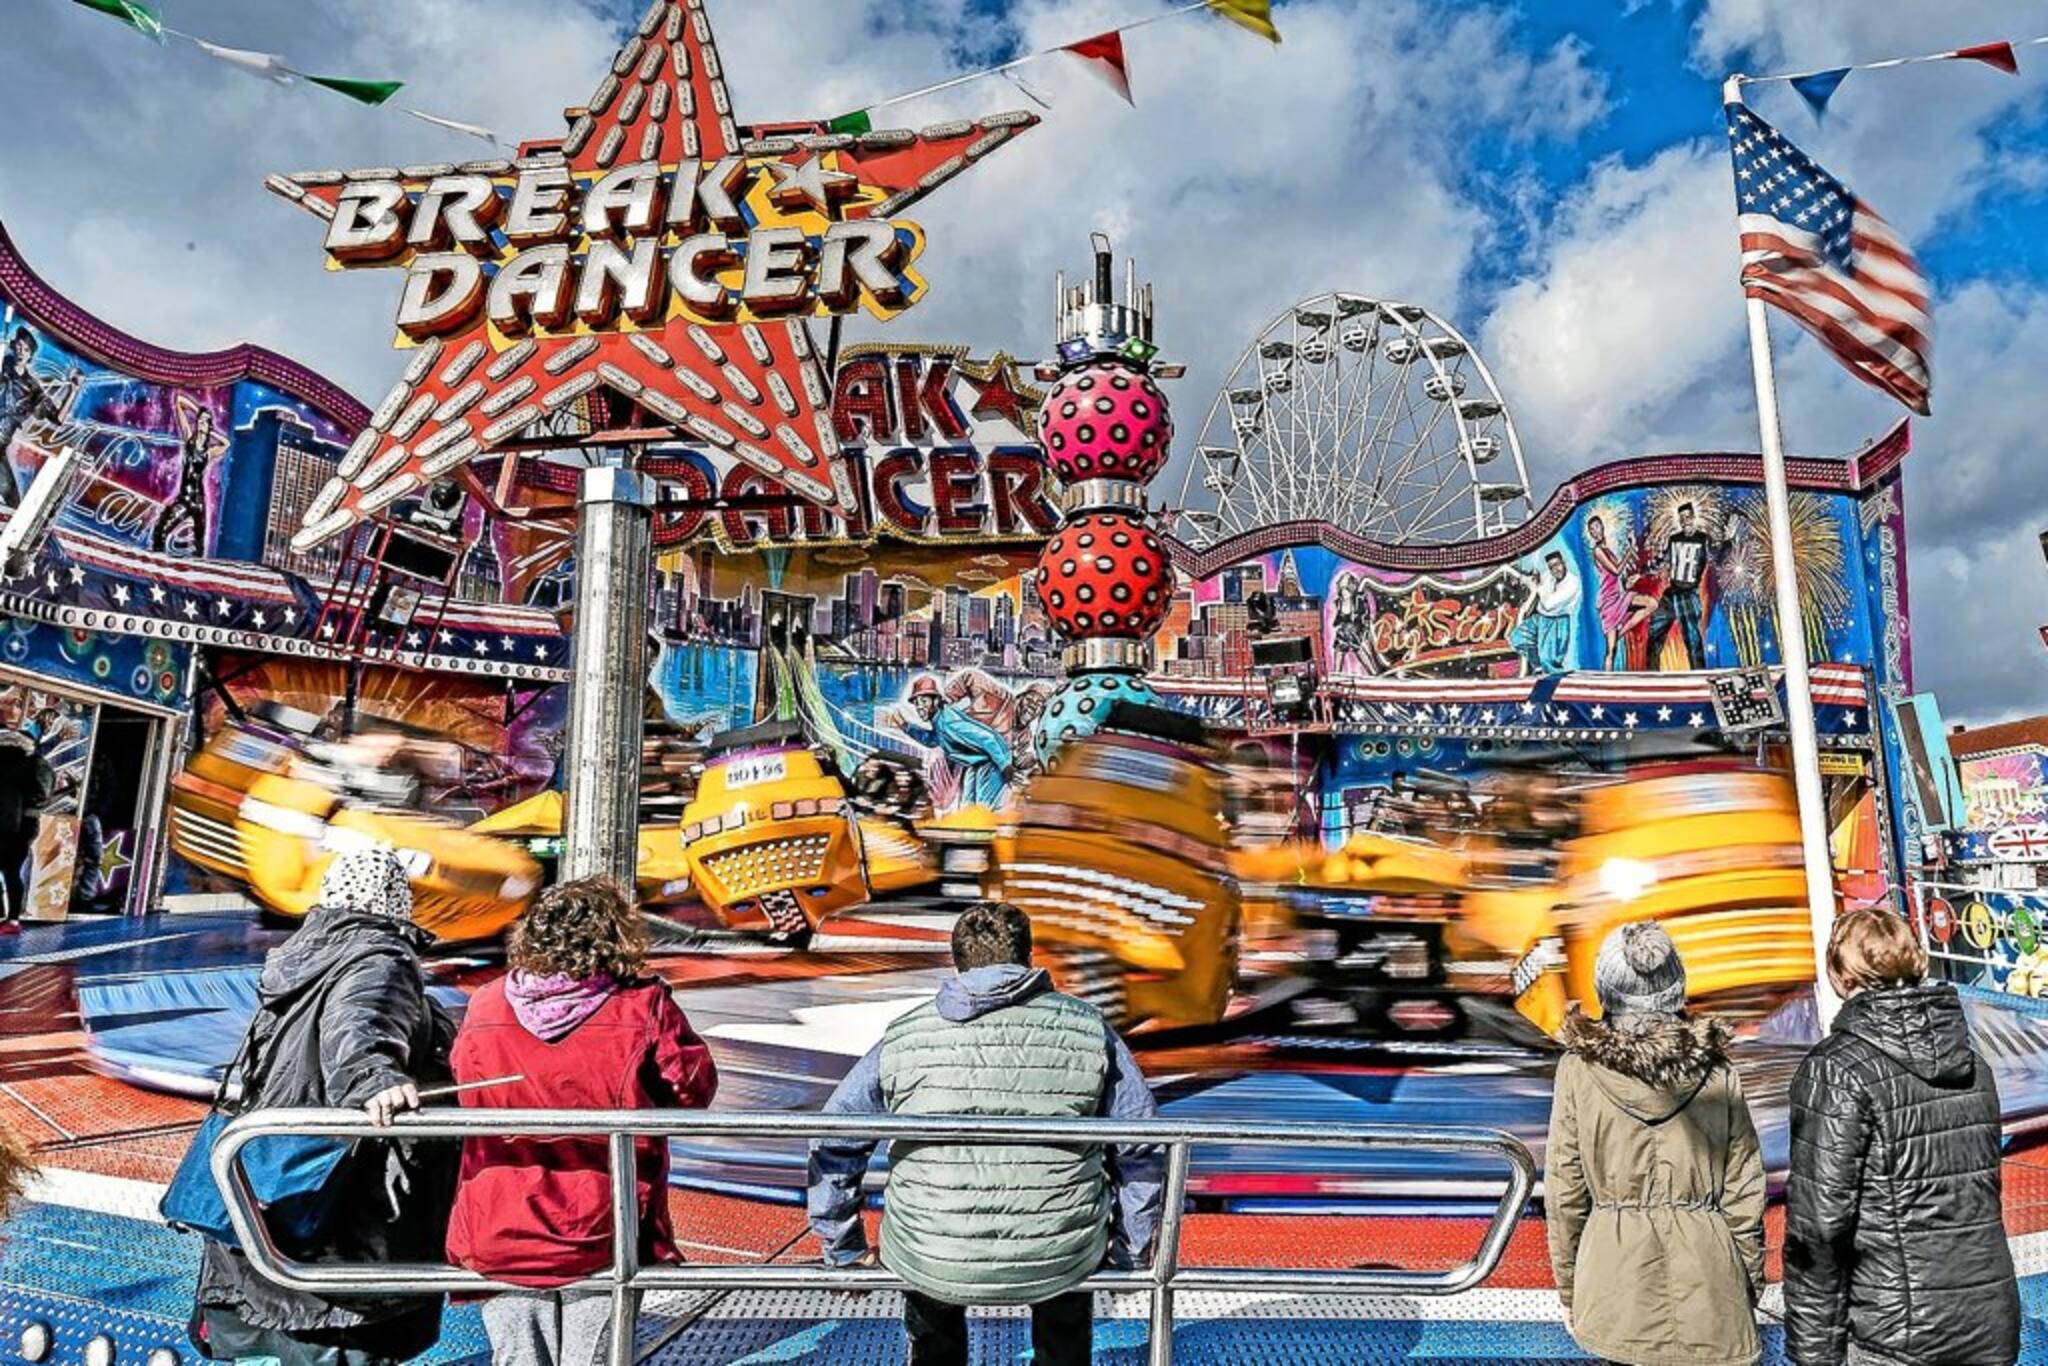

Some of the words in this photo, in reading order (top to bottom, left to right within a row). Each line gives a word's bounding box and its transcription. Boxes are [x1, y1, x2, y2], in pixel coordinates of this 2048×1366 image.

[323, 156, 747, 256] BREAK
[396, 217, 902, 328] DANCER
[1374, 611, 1427, 662] Big
[1426, 599, 1519, 648] Star
